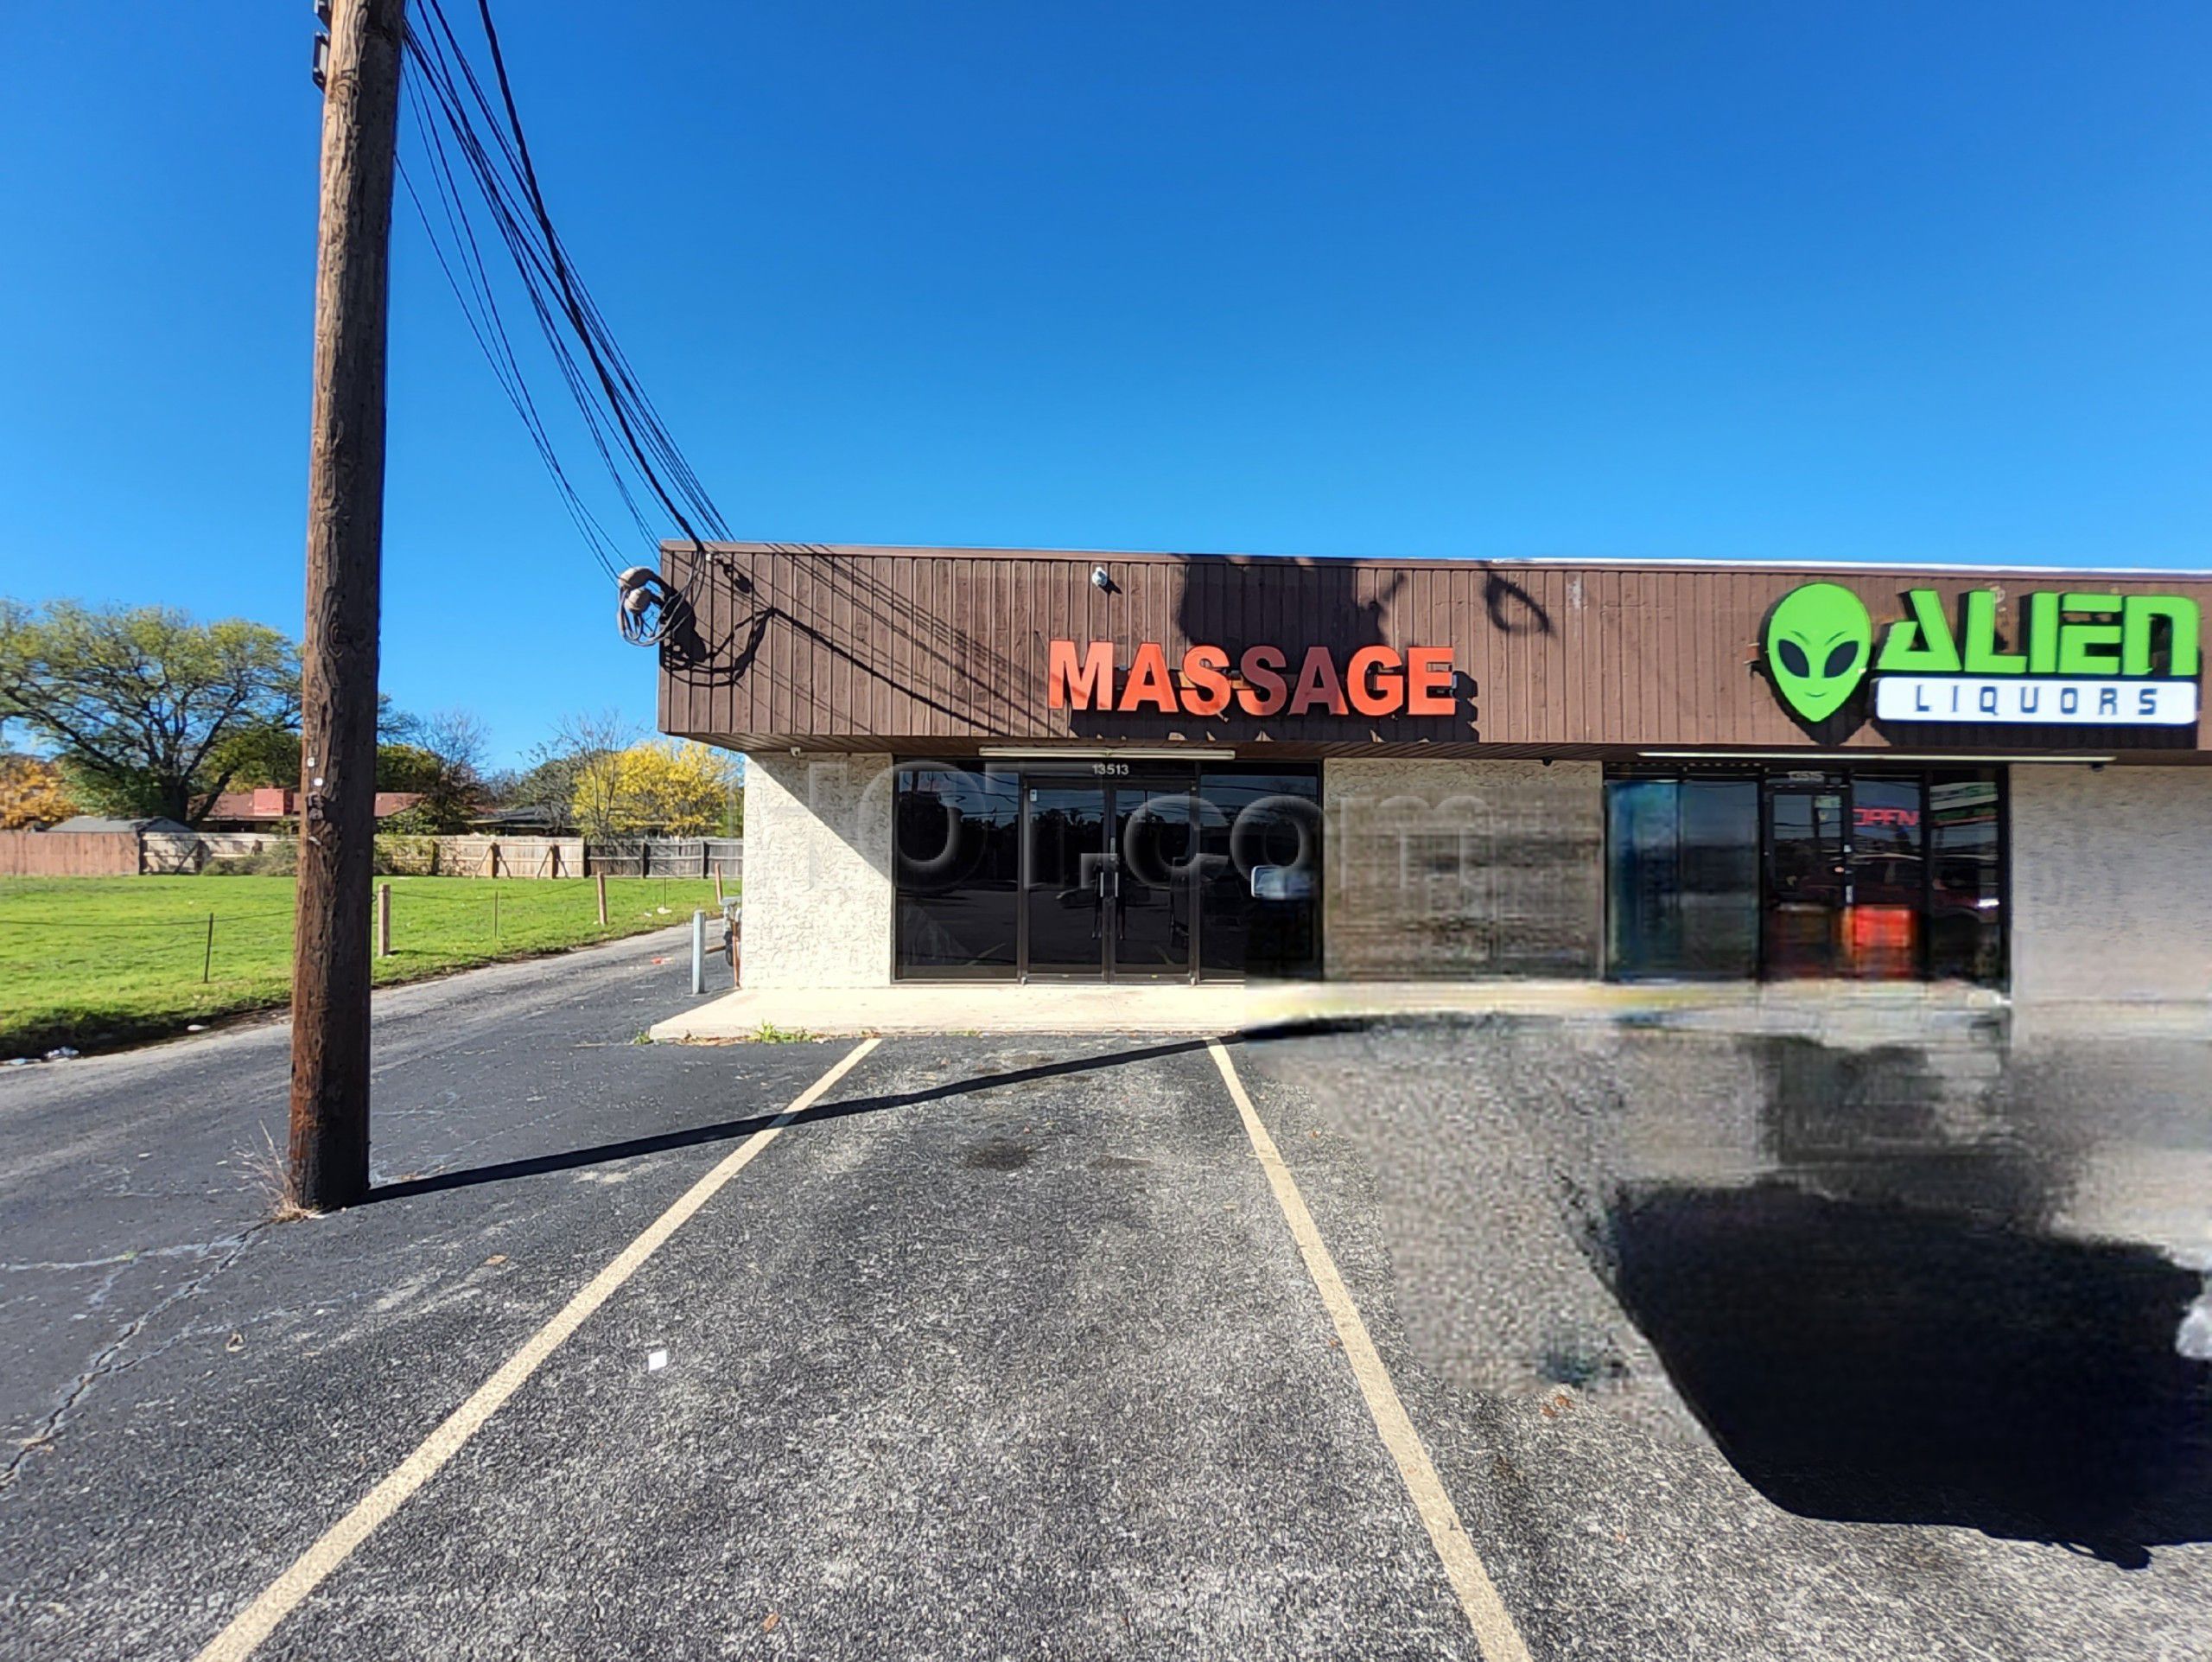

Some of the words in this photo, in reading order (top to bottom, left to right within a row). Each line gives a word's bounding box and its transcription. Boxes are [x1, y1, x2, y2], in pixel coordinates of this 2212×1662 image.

[1875, 589, 2199, 676] ALIEN
[1048, 640, 1456, 716] MASSAGE
[1915, 685, 2158, 716] LIQUORS
[1092, 762, 1129, 776] 13513
